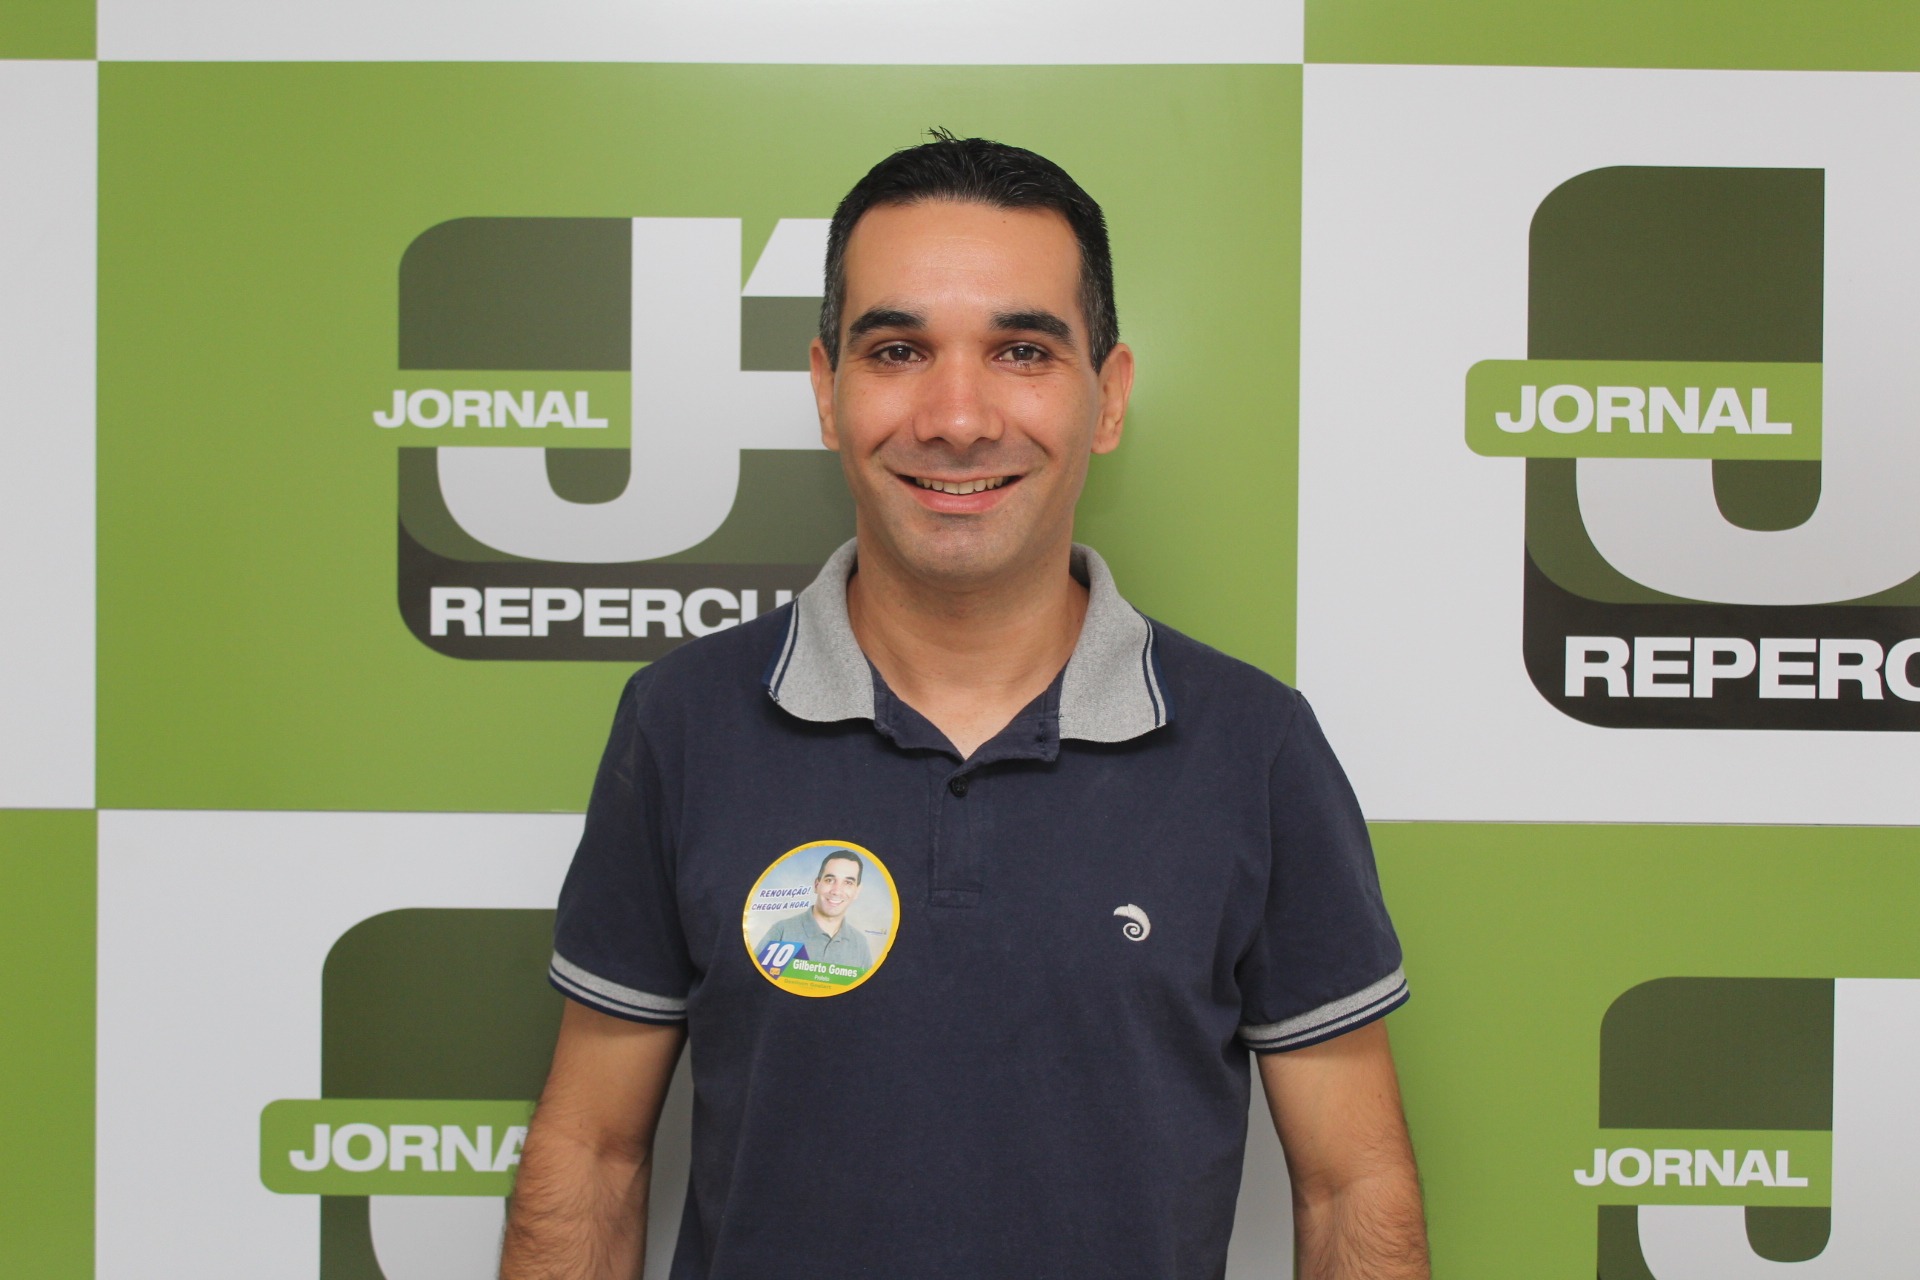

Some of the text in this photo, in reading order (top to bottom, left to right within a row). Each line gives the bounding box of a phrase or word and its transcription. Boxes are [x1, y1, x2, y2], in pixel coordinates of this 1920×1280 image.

[373, 388, 609, 429] JORNAL
[1495, 384, 1793, 435] JORNAL
[760, 885, 811, 898] RENOVAÇÃO!
[751, 903, 782, 911] CHEGOU
[790, 901, 810, 909] HORA
[761, 942, 795, 967] 10
[792, 959, 827, 974] Gilberto
[828, 964, 858, 978] Gomes
[1573, 1147, 1809, 1187] JORNAL
